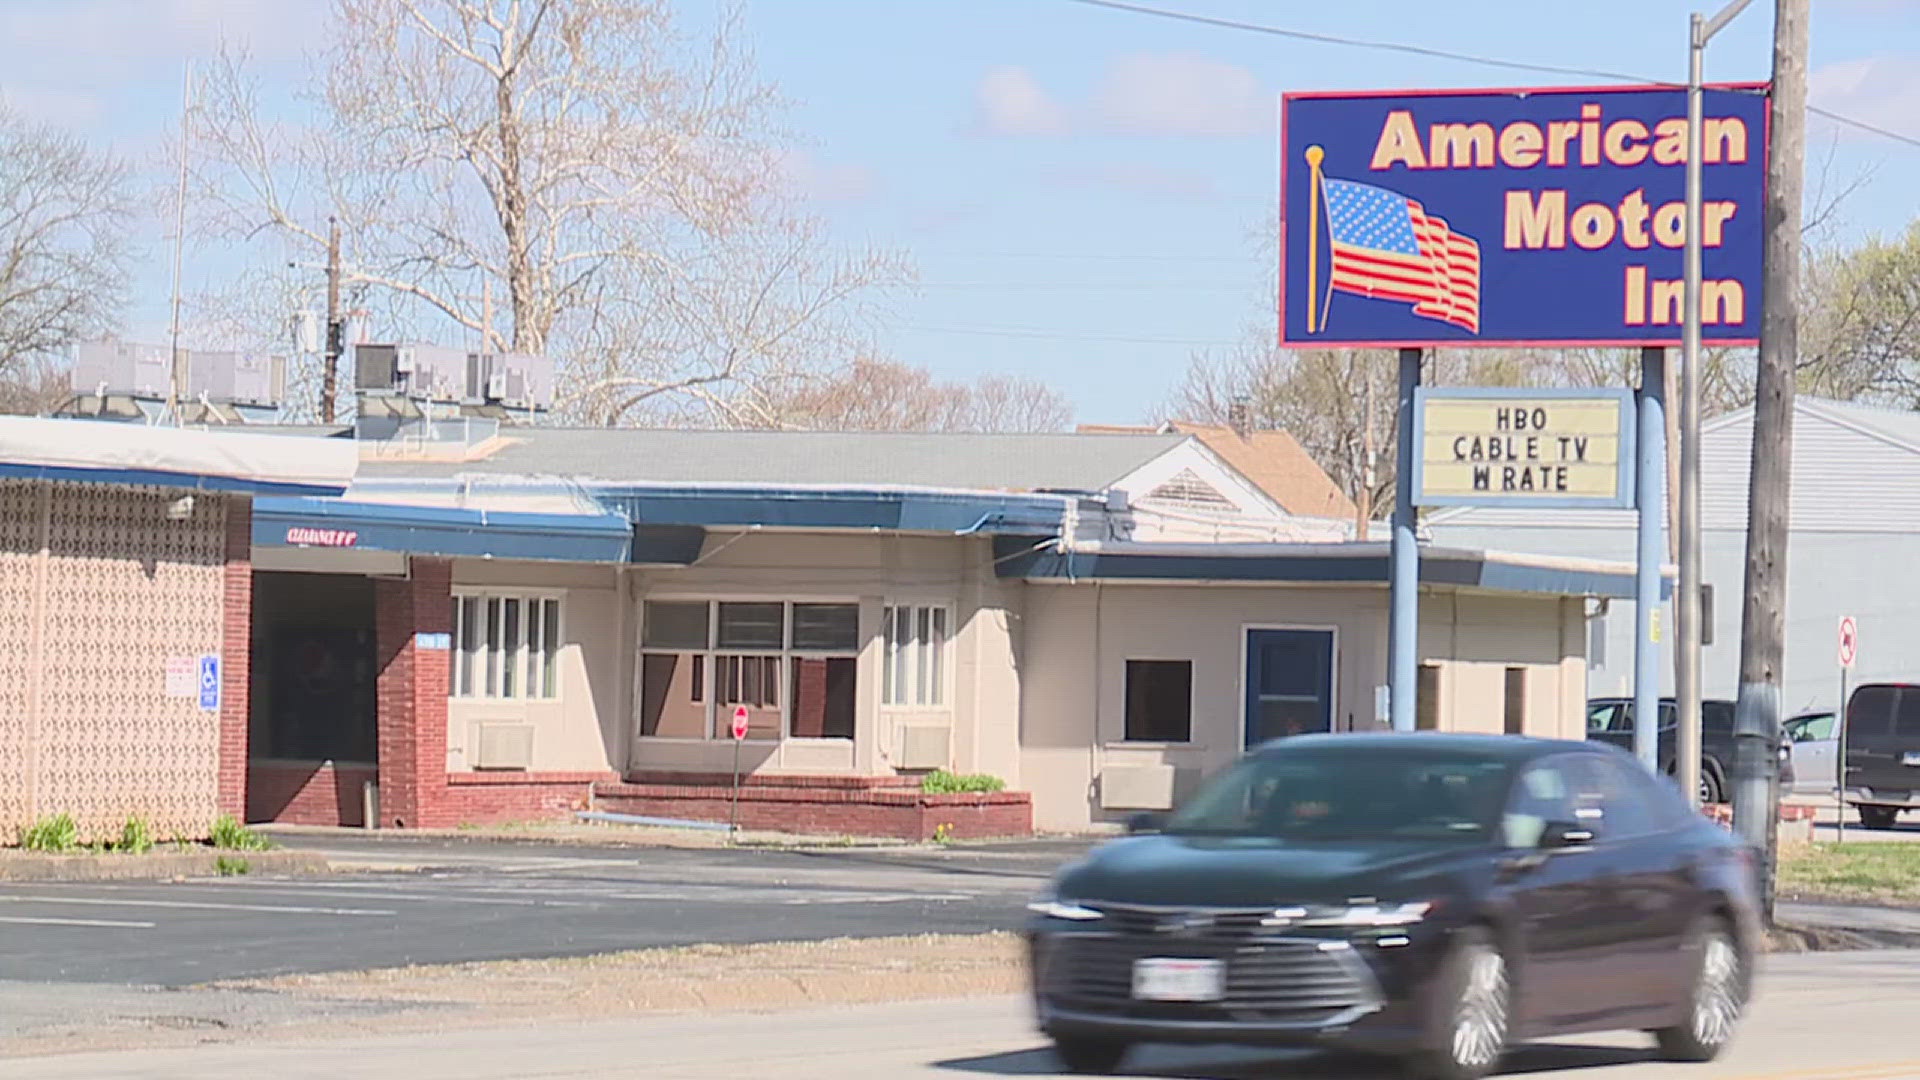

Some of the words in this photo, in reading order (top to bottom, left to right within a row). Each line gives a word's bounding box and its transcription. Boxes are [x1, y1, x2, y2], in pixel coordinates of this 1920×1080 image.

[1370, 104, 1747, 169] American
[1505, 188, 1736, 248] Motor
[1624, 265, 1744, 324] Inn
[1497, 407, 1546, 430] HBO
[1453, 436, 1539, 460] CABLE
[1558, 437, 1588, 461] TV
[1503, 467, 1568, 491] RATE
